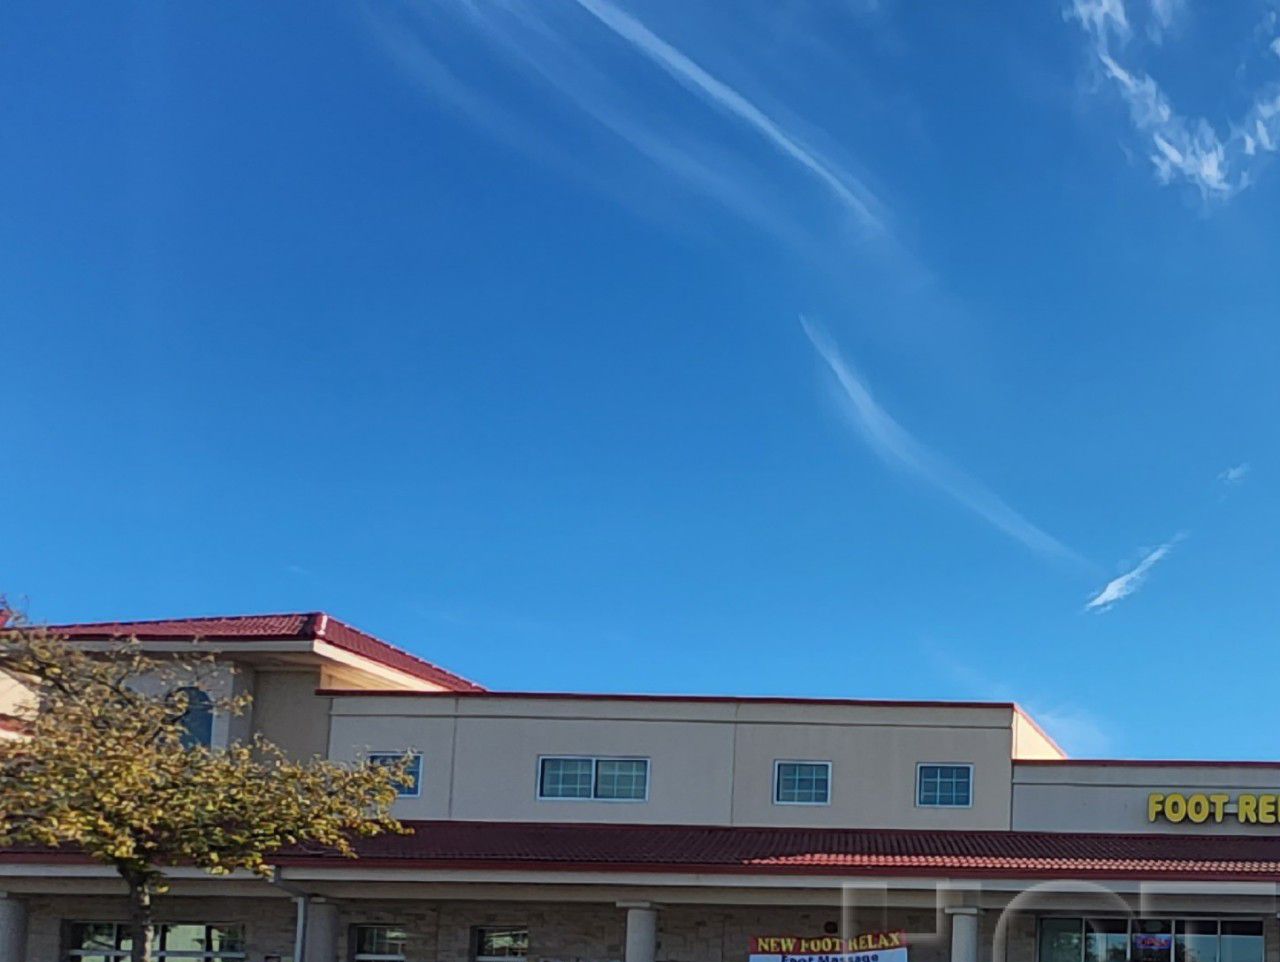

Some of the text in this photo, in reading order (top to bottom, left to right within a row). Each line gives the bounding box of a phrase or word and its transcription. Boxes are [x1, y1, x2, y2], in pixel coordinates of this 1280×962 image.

[1148, 792, 1230, 824] FOOT
[757, 932, 902, 953] NEW FOOT RELAX
